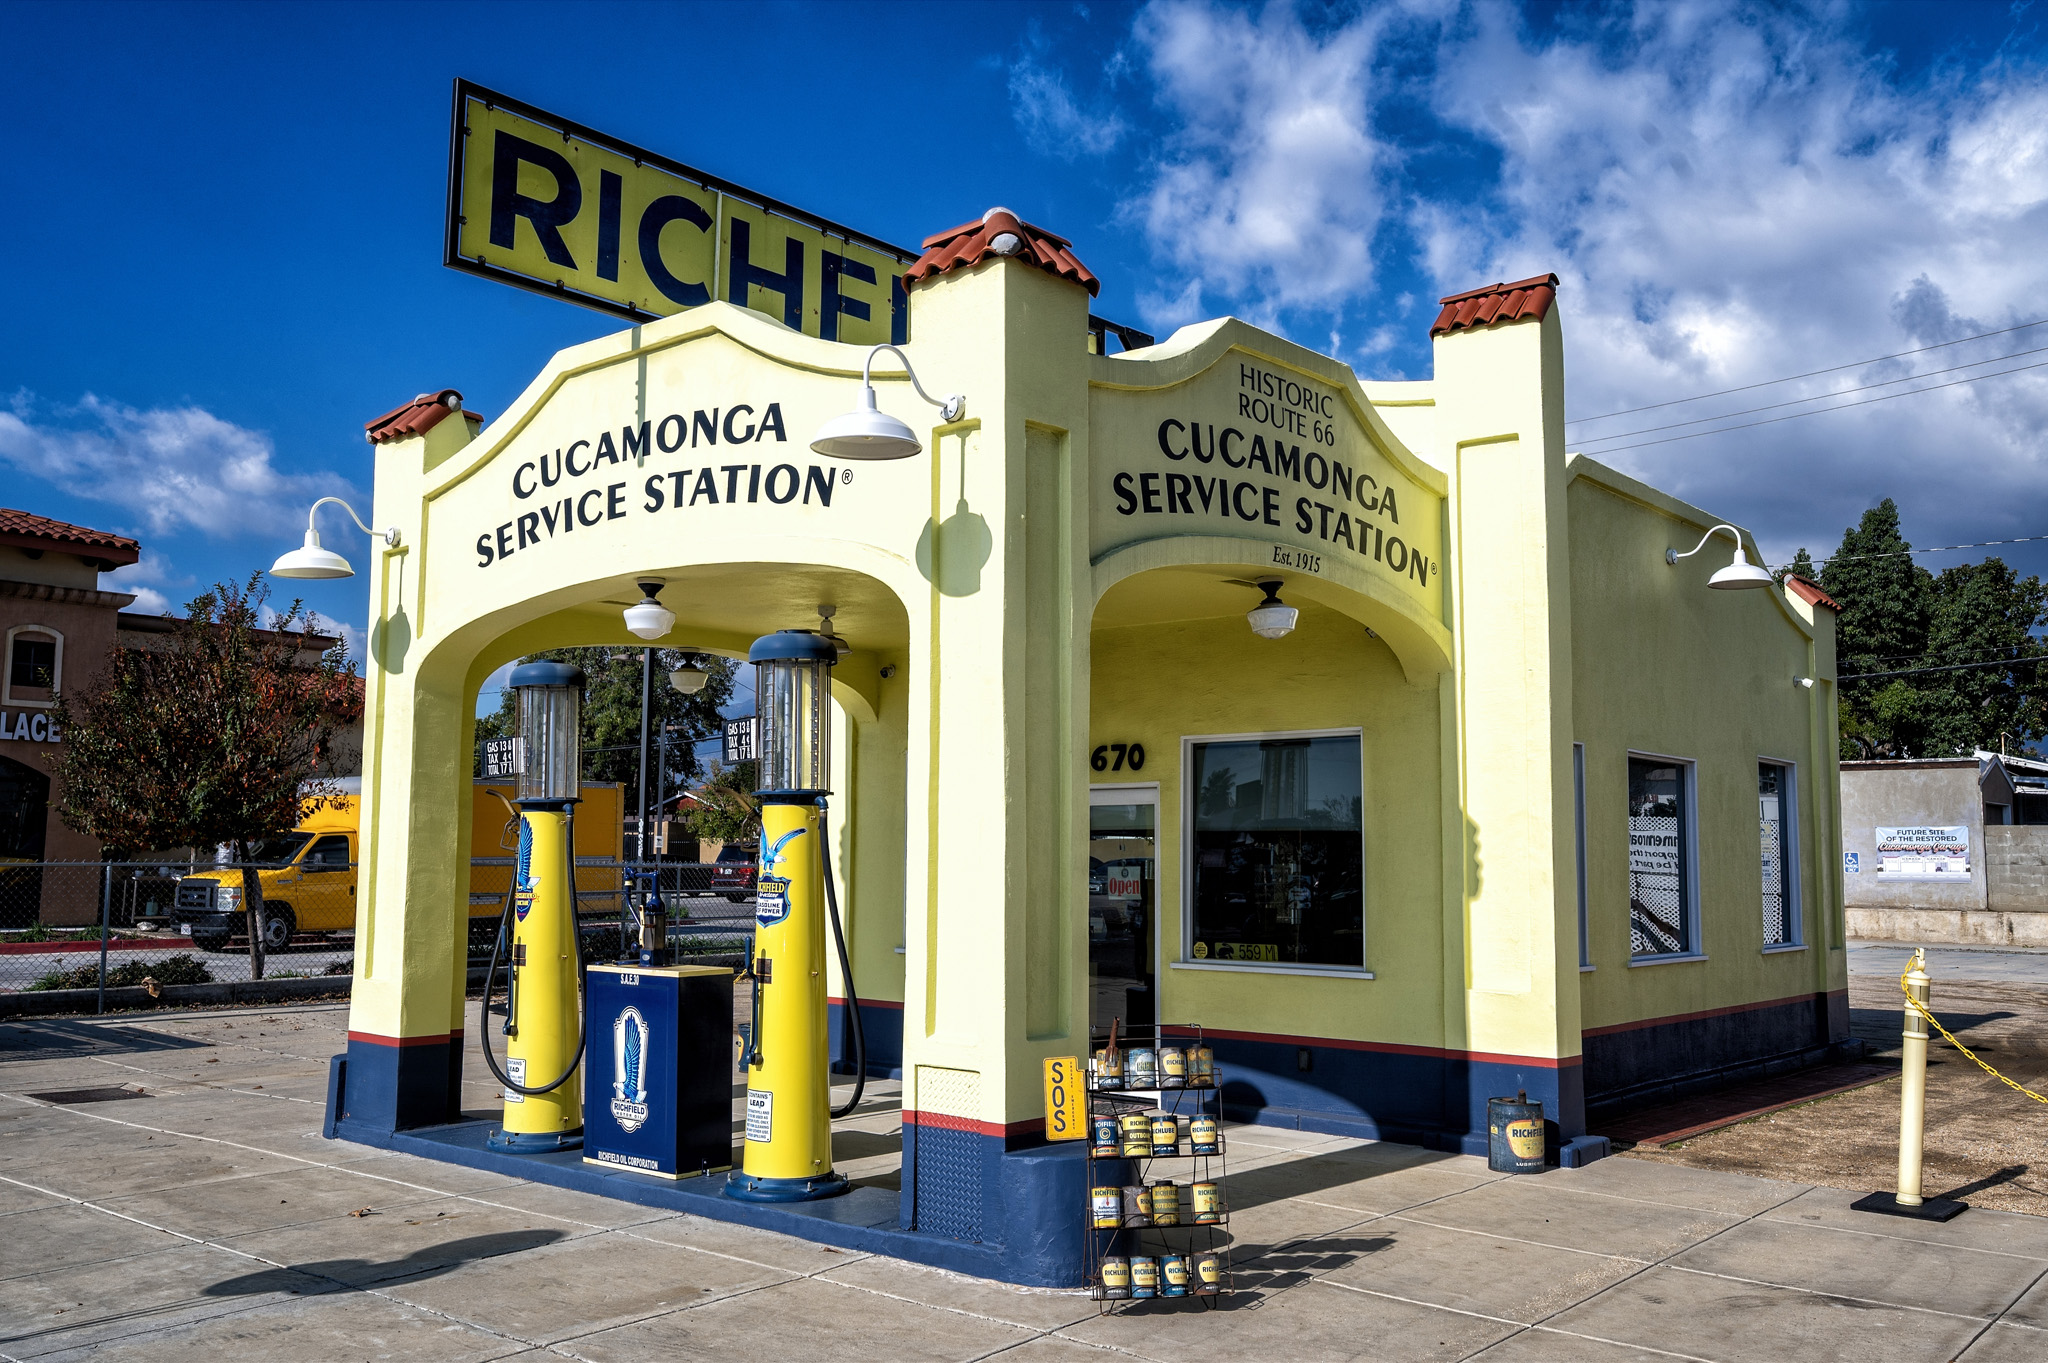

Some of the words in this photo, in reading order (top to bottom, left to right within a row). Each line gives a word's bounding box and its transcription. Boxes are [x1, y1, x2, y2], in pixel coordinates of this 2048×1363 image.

[1240, 363, 1333, 419] HISTORIC
[1239, 392, 1307, 438] ROUTE
[1313, 420, 1335, 446] 66
[512, 403, 787, 500] CUCAMONGA
[1158, 419, 1399, 525] CUCAMONGA
[1113, 472, 1281, 527] SERVICE
[476, 482, 626, 568] SERVICE
[1273, 546, 1292, 567] Est.
[1296, 554, 1321, 573] 1915
[0, 711, 61, 742] LACE
[727, 723, 738, 735] GAS
[487, 741, 498, 753] GAS
[728, 736, 738, 748] TAX
[487, 753, 499, 764] TAX
[1090, 744, 1145, 771] 670
[1878, 842, 1932, 854] Cucamonga
[1932, 842, 1967, 854] Garage
[1109, 877, 1140, 896] Open
[1239, 945, 1261, 960] 559
[614, 1102, 645, 1114] RICHFIELD
[749, 1099, 765, 1107] LEAD
[597, 1151, 619, 1163] RICHFIELD
[628, 1156, 658, 1170] CORPORATION
